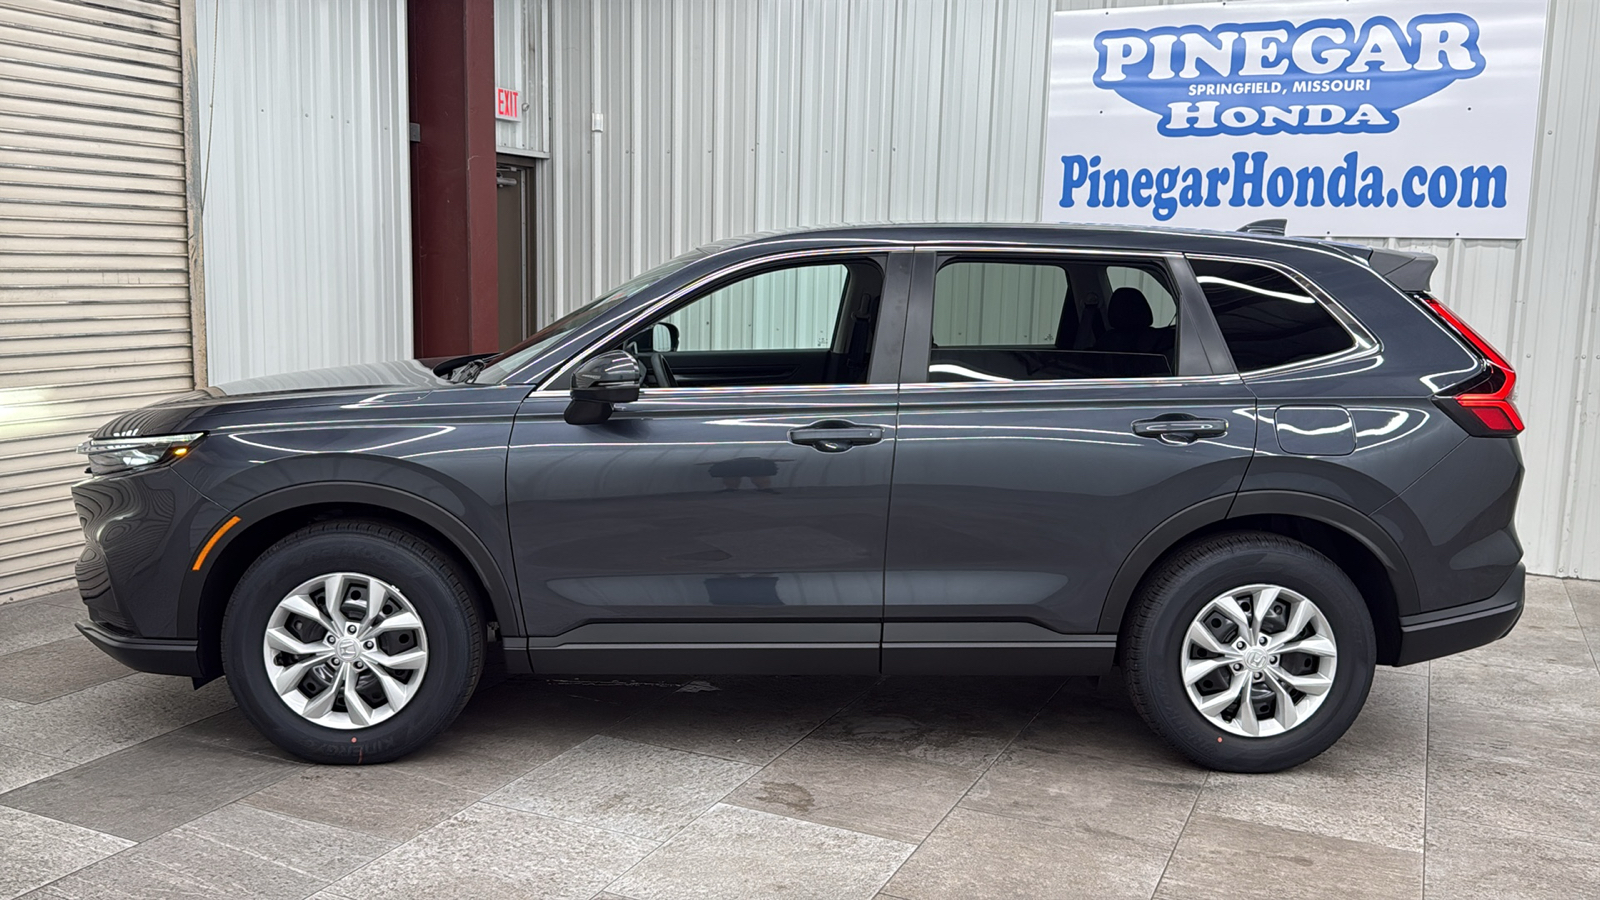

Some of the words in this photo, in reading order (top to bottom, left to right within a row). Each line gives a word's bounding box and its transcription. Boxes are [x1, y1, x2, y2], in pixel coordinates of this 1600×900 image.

[1100, 22, 1477, 82] PINEGAR
[497, 88, 519, 118] EXIT
[1187, 81, 1287, 97] SPRINGFIELD,
[1292, 79, 1371, 93] MISSOURI
[1165, 101, 1390, 130] HONDA
[1059, 151, 1508, 221] PinegarHonda.com
